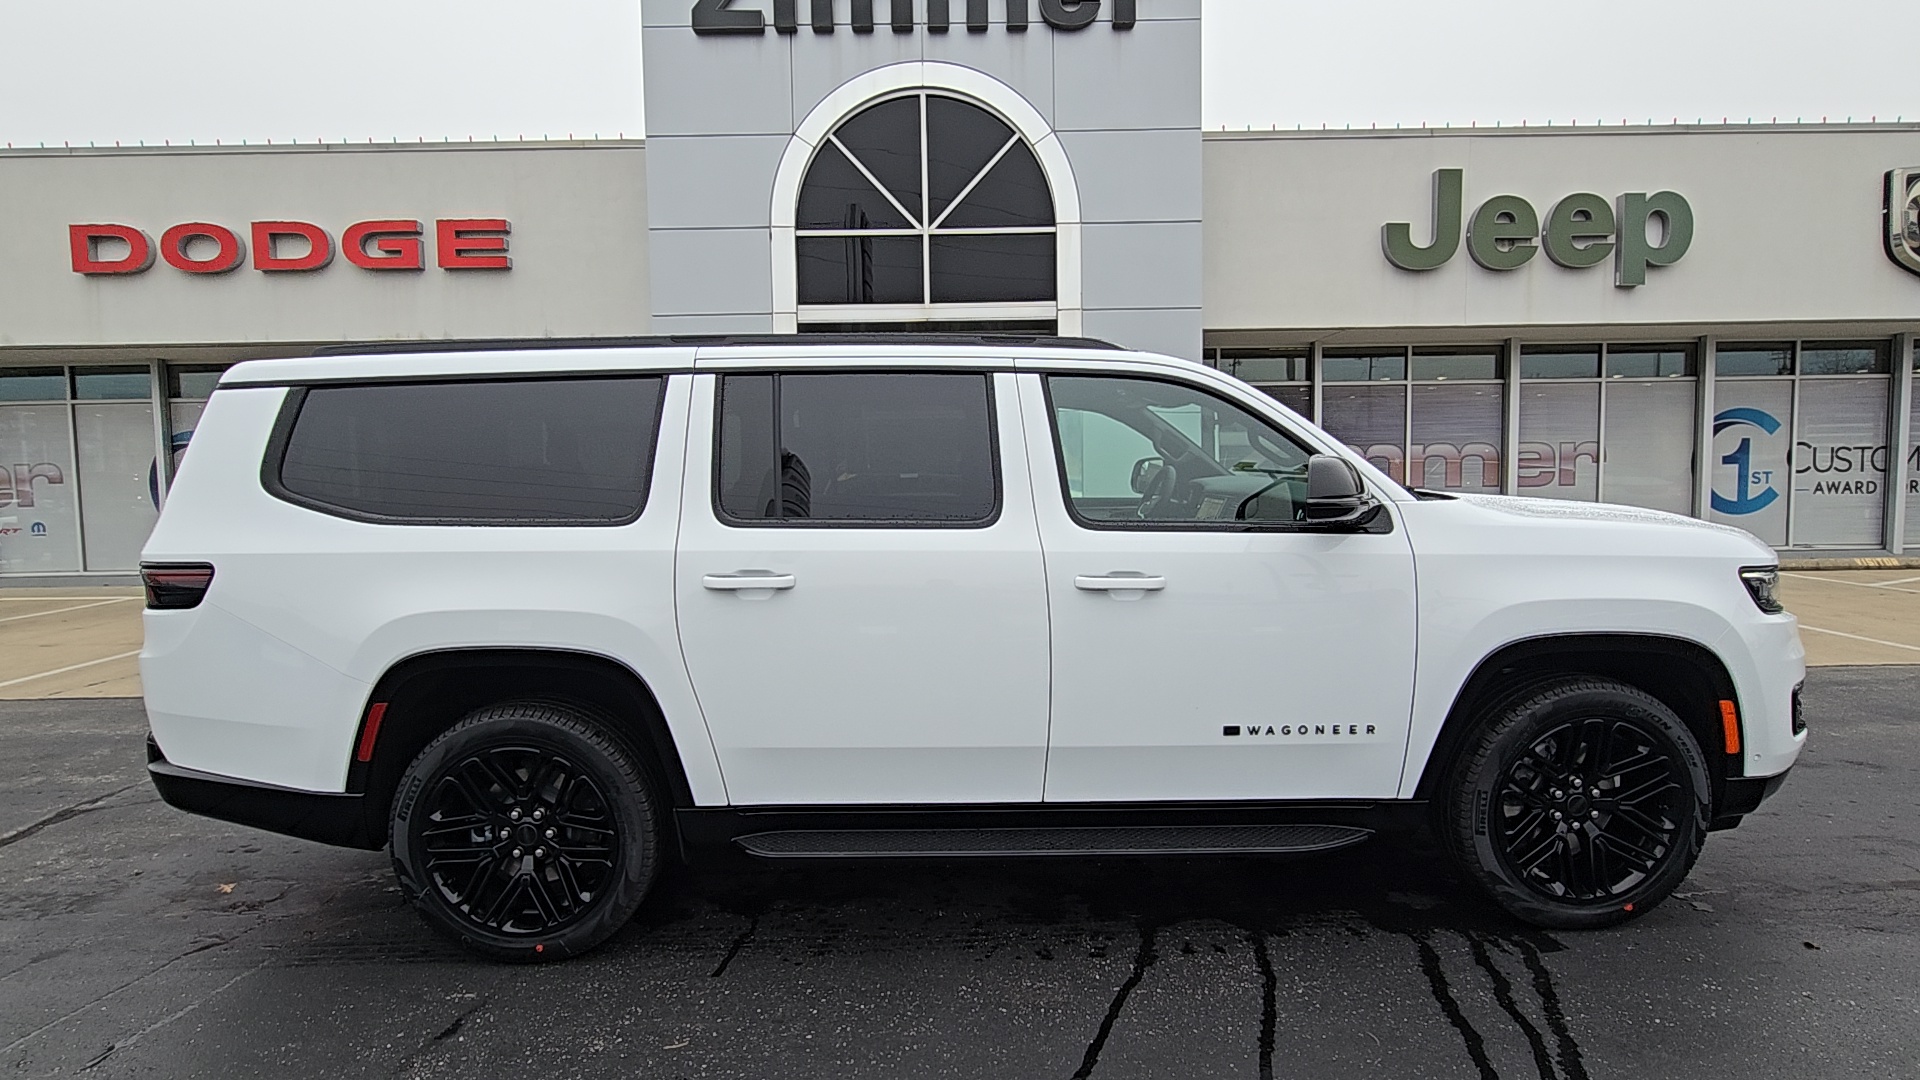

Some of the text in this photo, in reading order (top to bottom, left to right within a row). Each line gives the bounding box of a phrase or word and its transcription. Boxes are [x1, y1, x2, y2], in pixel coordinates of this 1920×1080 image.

[68, 218, 513, 275] DODGE
[1381, 168, 1694, 288] Jeep
[1812, 480, 1878, 495] AWARD
[1246, 724, 1376, 736] WAGONEER
[1475, 789, 1489, 836] PIRELLI
